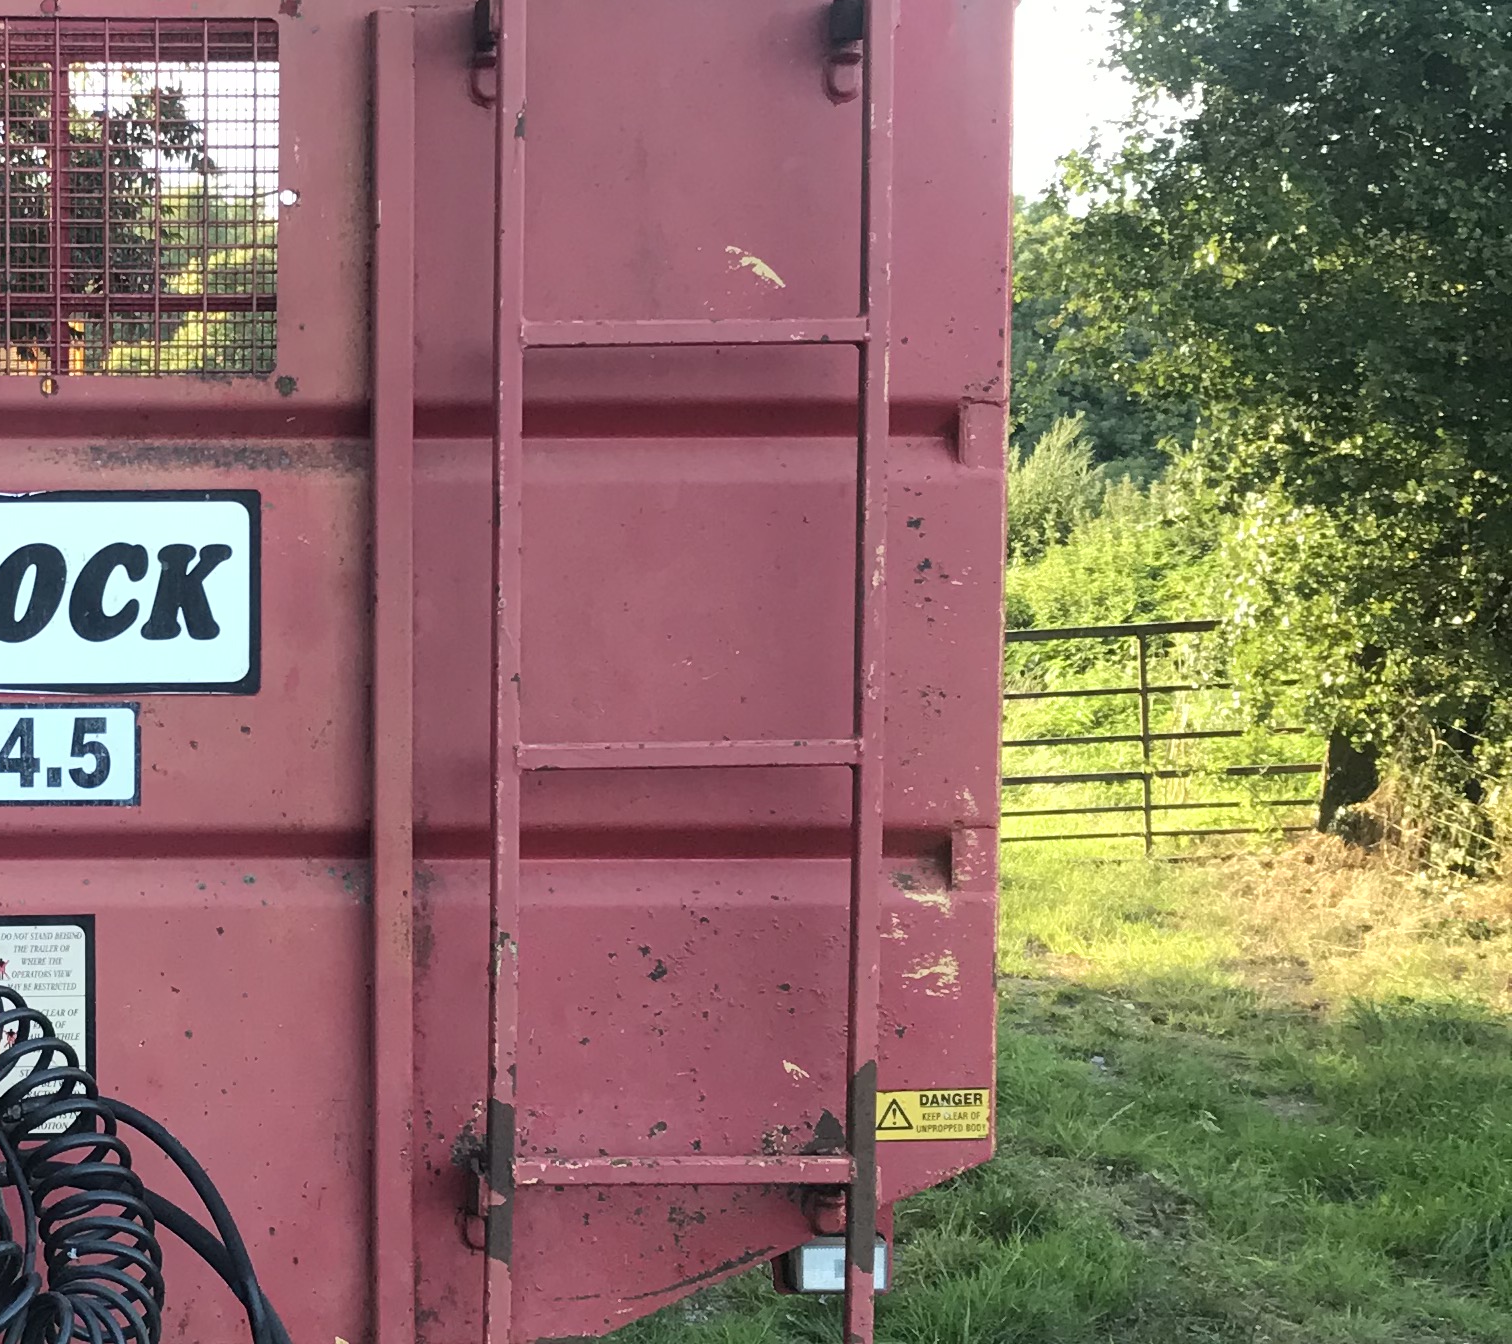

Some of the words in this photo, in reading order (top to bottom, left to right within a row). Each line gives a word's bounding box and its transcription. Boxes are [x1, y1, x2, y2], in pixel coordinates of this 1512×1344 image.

[1, 932, 12, 940] DO
[13, 932, 29, 940] NOT
[30, 932, 53, 940] STAND
[54, 932, 82, 940] BEHIND
[14, 945, 29, 953] THE
[30, 945, 58, 953] TRAILER
[59, 944, 71, 952] OR
[21, 957, 46, 966] WHERE
[48, 957, 63, 966] THE
[11, 970, 52, 978] OPERATORS
[53, 970, 72, 978] VIEW
[23, 983, 31, 991] BE
[33, 982, 77, 991] RESTRICTED
[67, 1008, 79, 1017] OF
[55, 1020, 67, 1029] OF
[919, 1093, 983, 1106] DANGER
[922, 1113, 941, 1121] KEEP
[943, 1112, 969, 1121] CLEAR
[970, 1111, 981, 1120] OF
[916, 1124, 964, 1133] UNPROPPED
[965, 1123, 986, 1132] BODY
